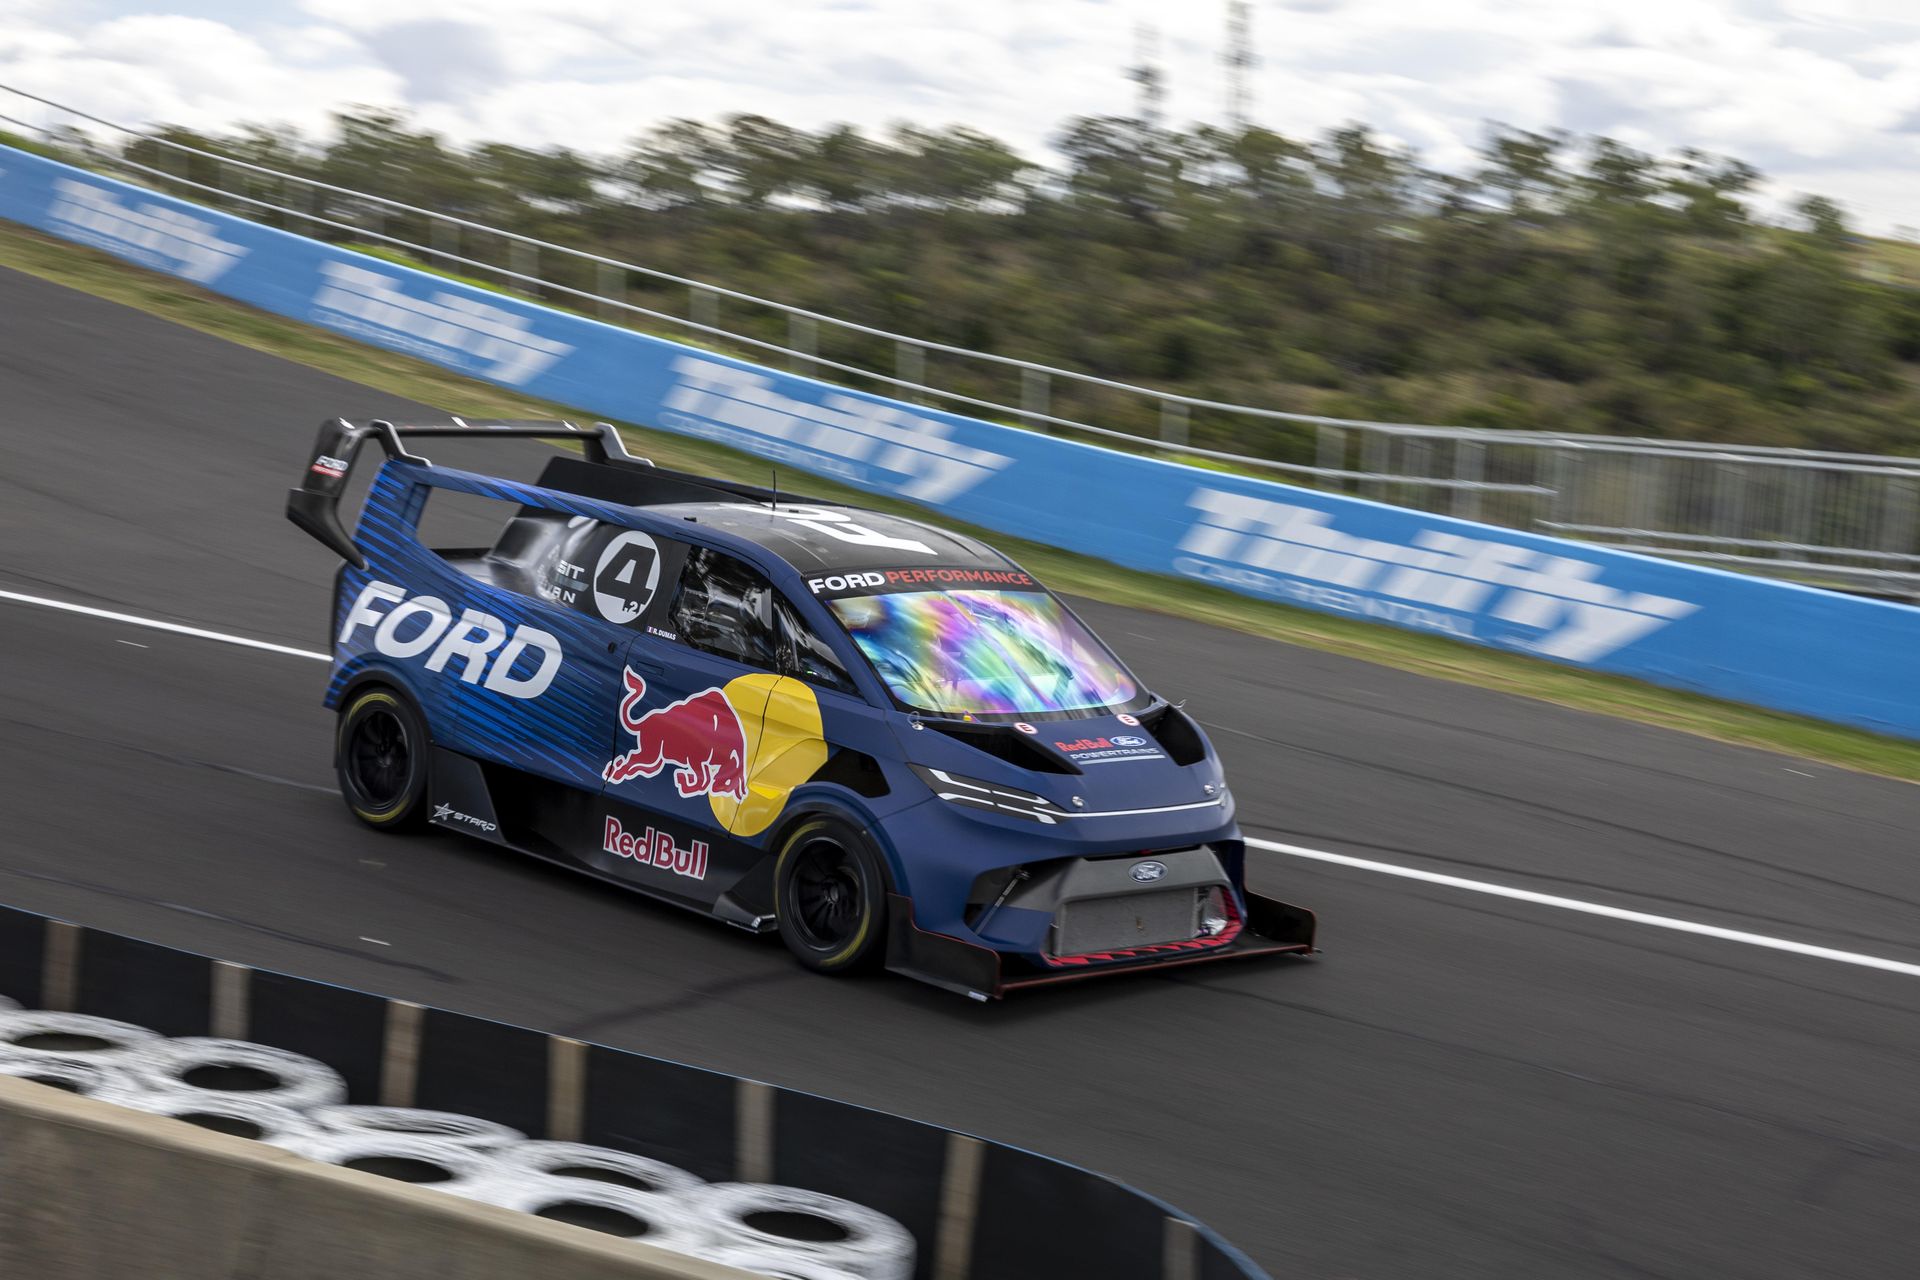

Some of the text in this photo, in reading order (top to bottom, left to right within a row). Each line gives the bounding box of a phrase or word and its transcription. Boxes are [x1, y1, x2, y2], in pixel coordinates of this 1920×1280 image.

[808, 570, 1033, 594] FORD PERFORMANCE
[1175, 487, 1703, 663] Thrifty
[338, 580, 563, 699] FORD
[1055, 739, 1085, 752] Red
[1084, 737, 1113, 749] Bull
[1069, 747, 1160, 760] POWERTRAINS
[603, 815, 709, 880] Red Bull
